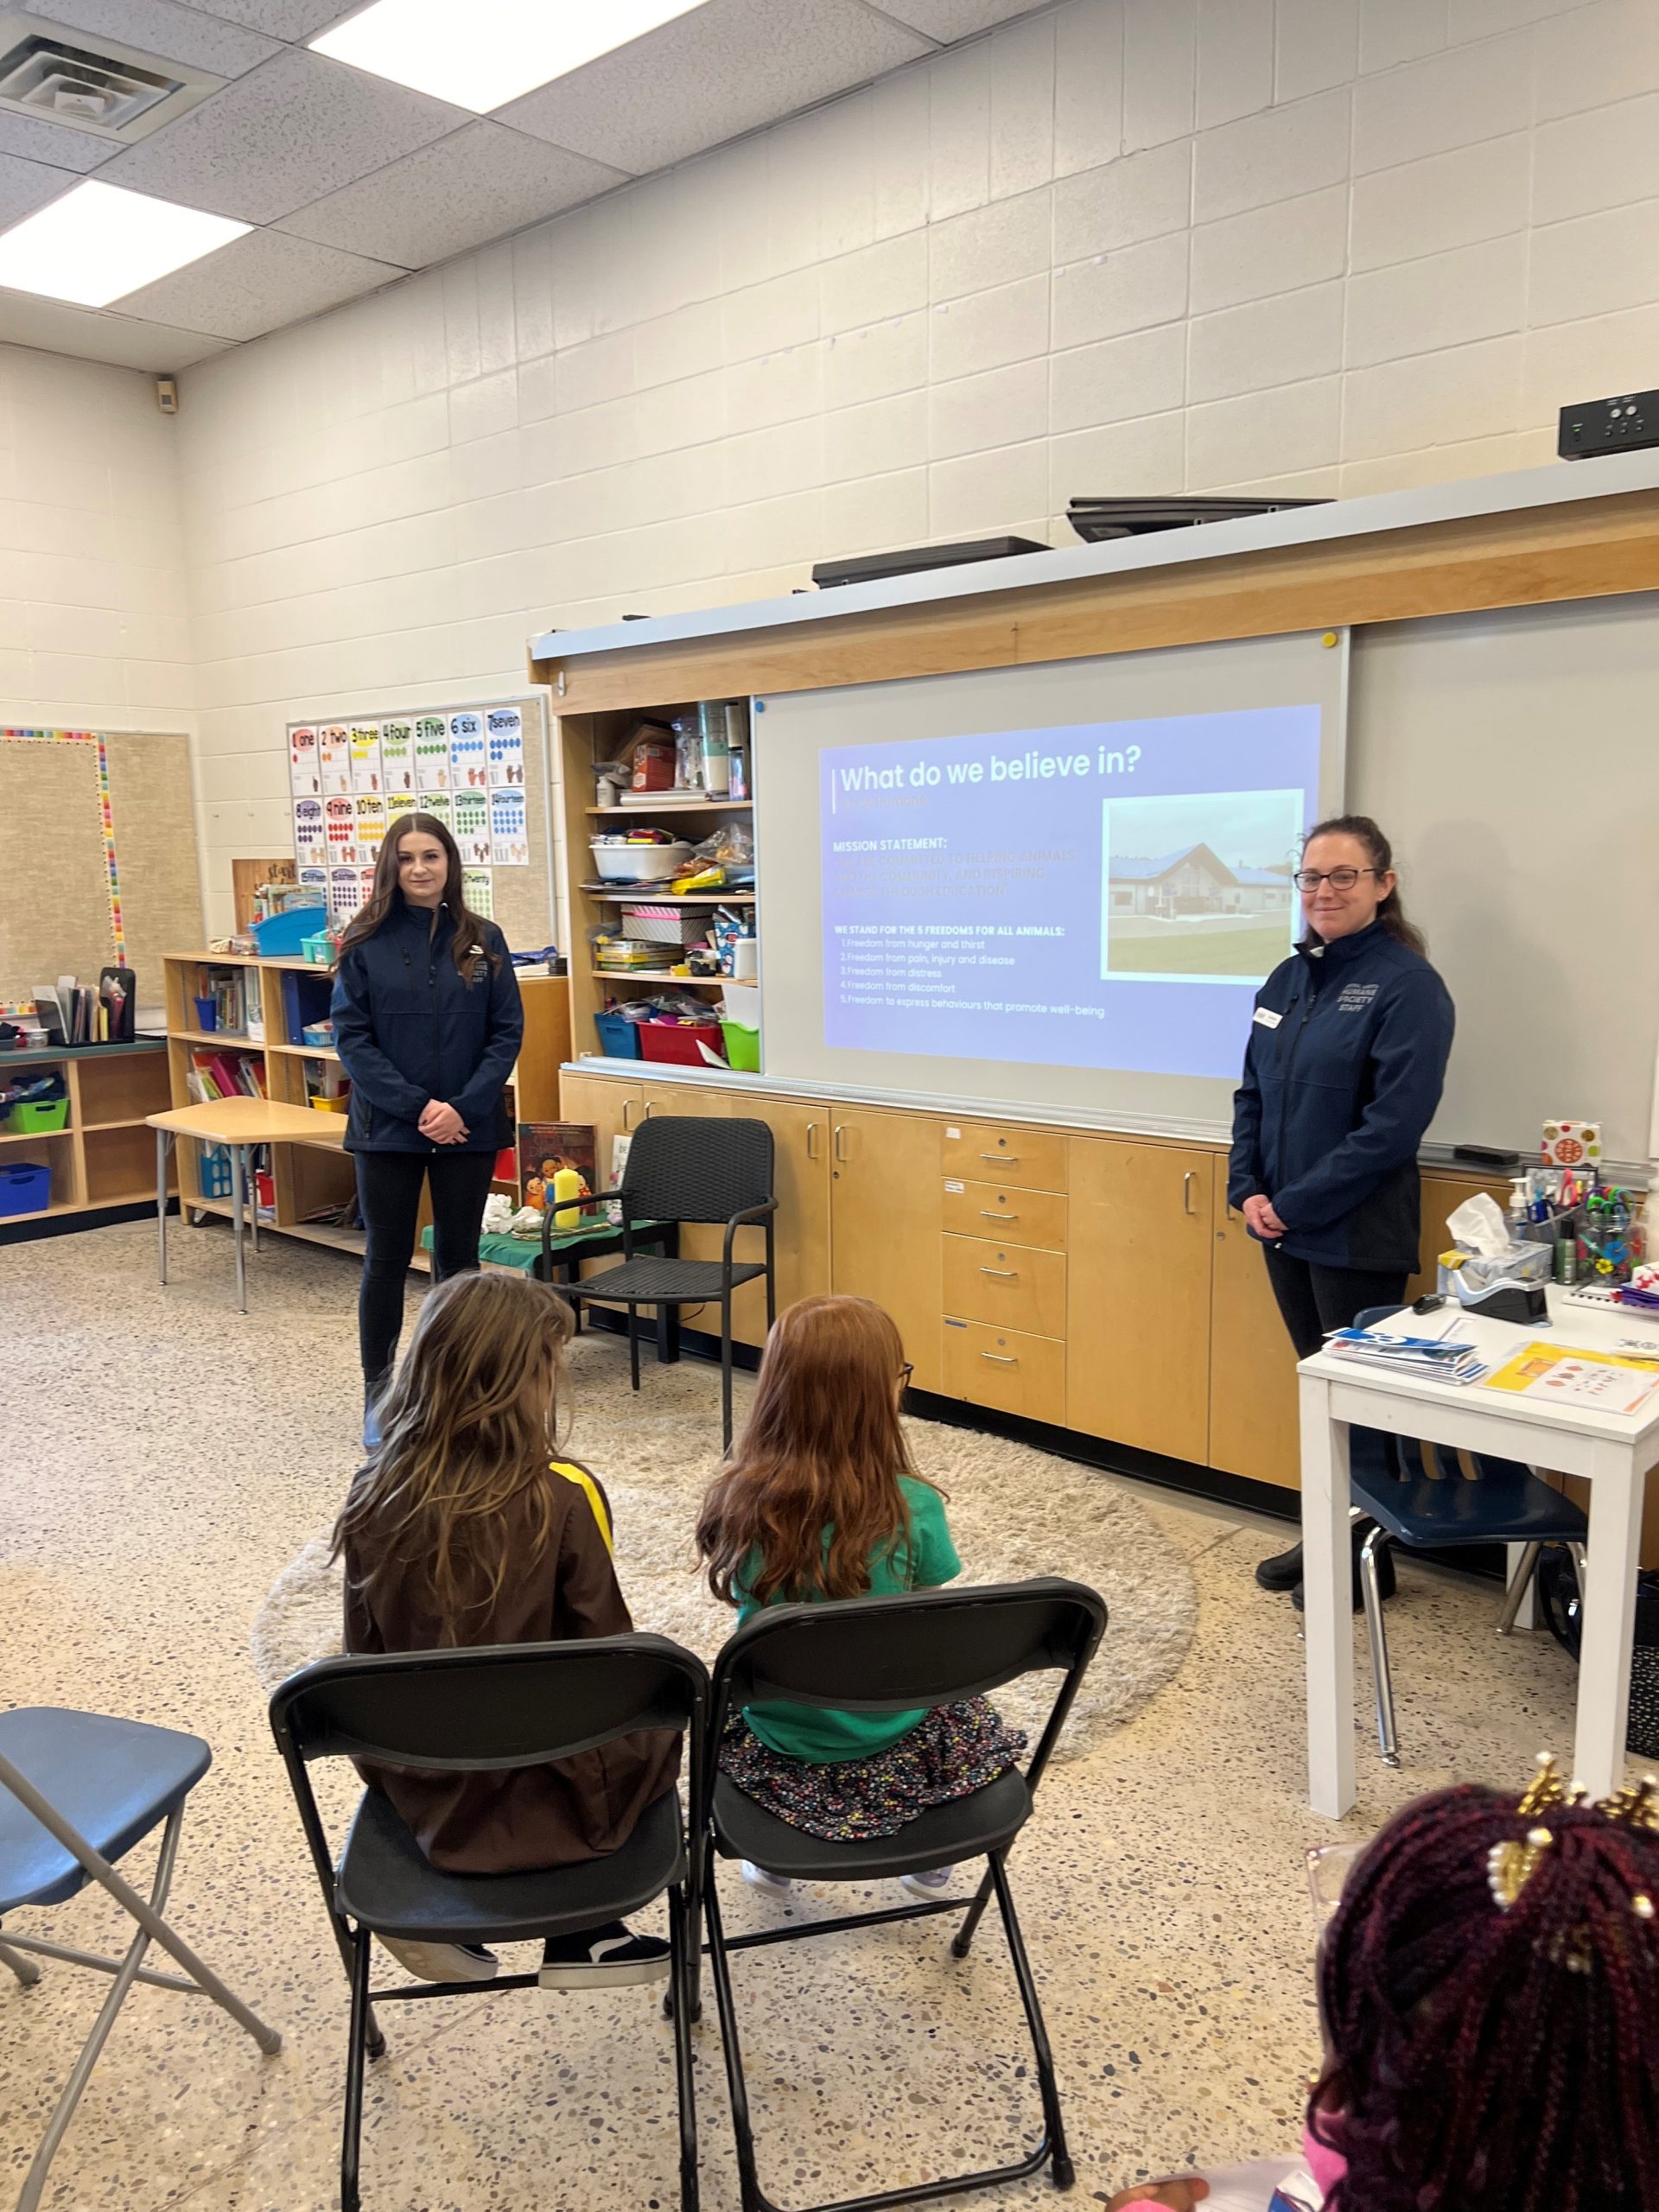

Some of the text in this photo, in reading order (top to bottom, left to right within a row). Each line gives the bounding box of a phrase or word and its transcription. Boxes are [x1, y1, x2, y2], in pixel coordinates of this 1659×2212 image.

[840, 745, 1141, 791] What do we believe in?
[833, 837, 948, 853] MISSION STATEMENT:
[879, 854, 944, 866] COMMITTED
[948, 853, 963, 864] TO
[966, 851, 1016, 863] HELPING
[1019, 849, 1076, 862] ANIMALS
[955, 868, 981, 880] AND
[984, 867, 1045, 880] INSPIRING
[835, 925, 848, 934] WE
[849, 925, 878, 934] STAND
[880, 925, 896, 934] FOR
[899, 925, 915, 934] THE
[925, 925, 974, 935] FREEDOMS
[976, 926, 995, 935] FOR
[997, 926, 1014, 936] ALL
[1015, 926, 1065, 937] ANIMALS:
[886, 938, 906, 948] from
[907, 938, 938, 951] hunger
[941, 939, 959, 949] and
[961, 939, 985, 950] thirst
[886, 953, 906, 963] from
[908, 954, 929, 965] pain,
[931, 954, 956, 966] injury
[958, 955, 976, 965] and
[978, 955, 1015, 966] disease
[886, 967, 906, 977] from
[908, 969, 942, 978] distress
[886, 982, 906, 991] from
[908, 982, 956, 994] discomfort
[886, 997, 895, 1006] to
[897, 998, 930, 1009] express
[931, 999, 982, 1010] behaviours
[983, 1001, 1003, 1011] that
[1005, 1002, 1047, 1014] promote
[1050, 1005, 1105, 1020] well-being
